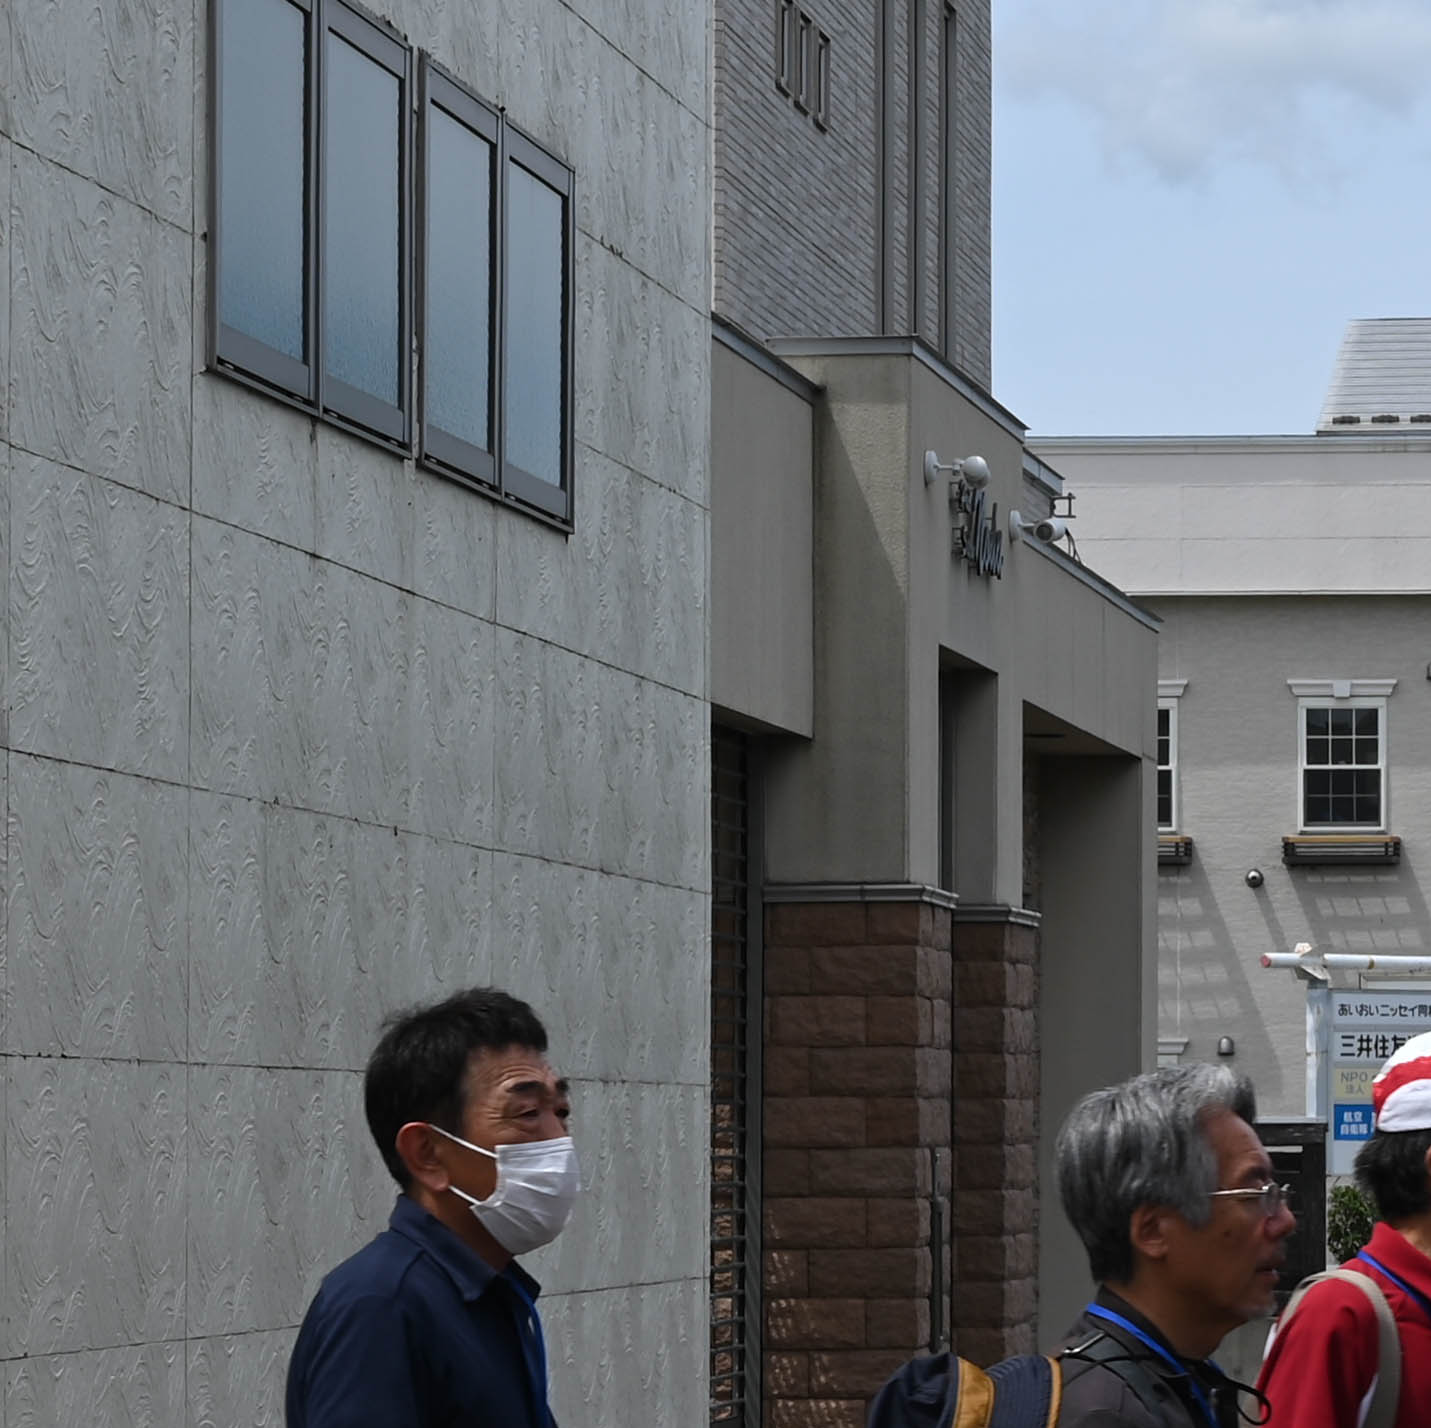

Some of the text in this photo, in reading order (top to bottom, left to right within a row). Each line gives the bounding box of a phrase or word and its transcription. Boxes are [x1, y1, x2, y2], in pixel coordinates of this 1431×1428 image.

[1340, 1034, 1414, 1058] 三井住友
[1340, 1071, 1368, 1083] NPO
